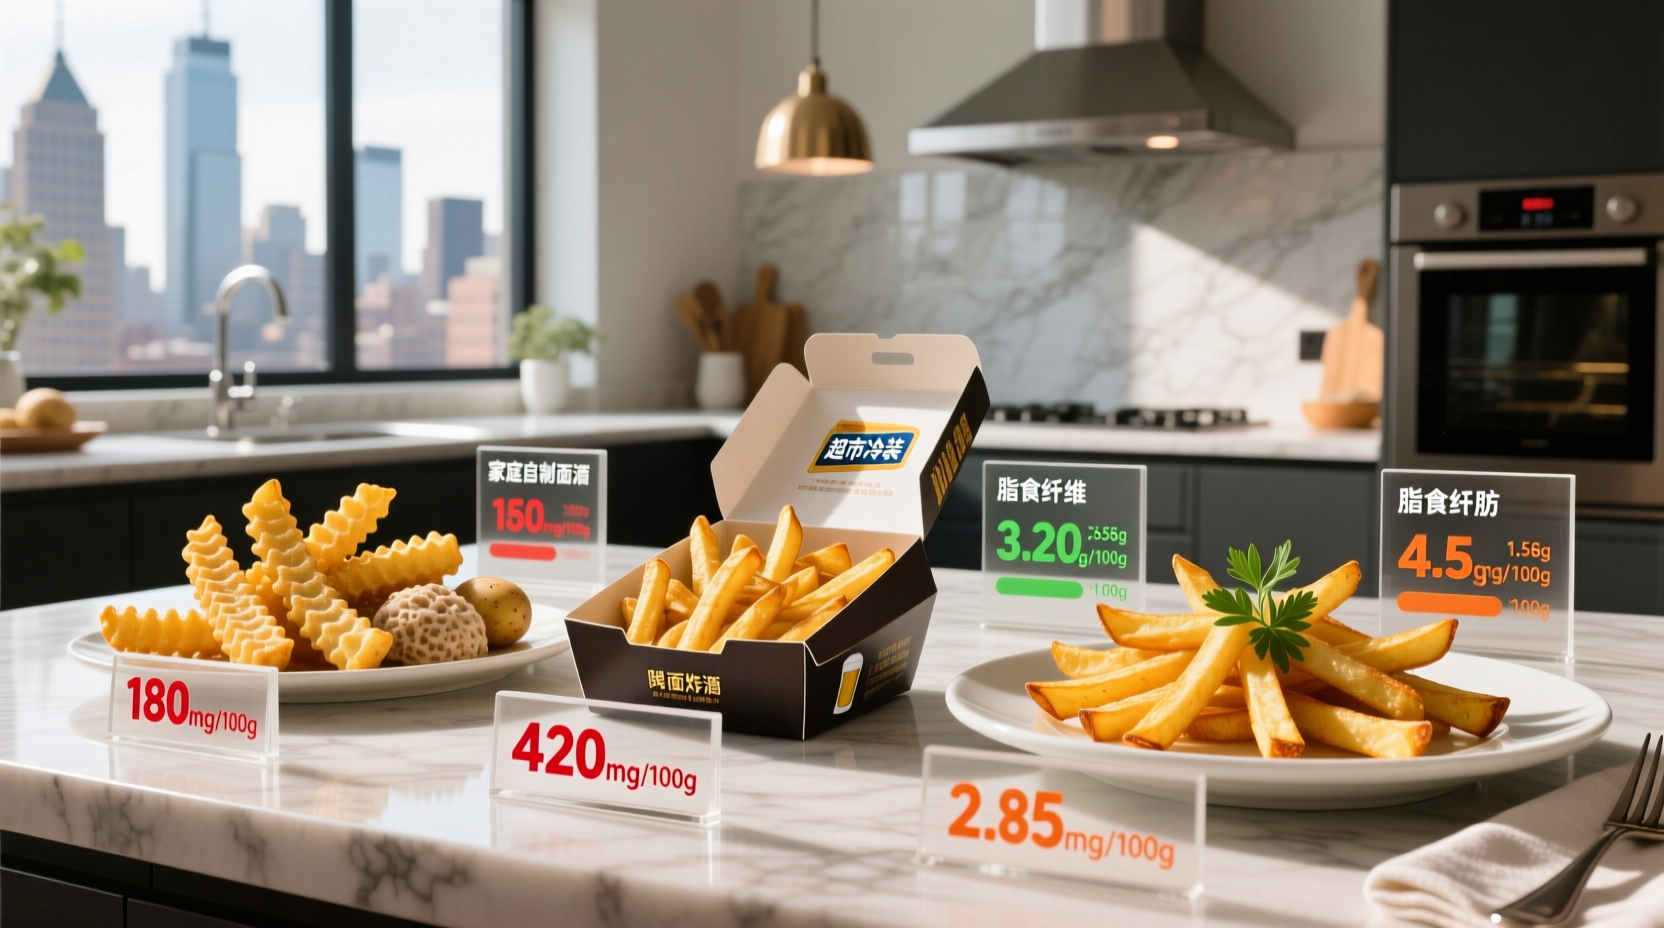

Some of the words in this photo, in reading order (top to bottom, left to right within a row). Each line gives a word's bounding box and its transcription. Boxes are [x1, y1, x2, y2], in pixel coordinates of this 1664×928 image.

[996, 476, 1087, 505] 脂食纤维
[1398, 486, 1500, 517] 脂食纤肪
